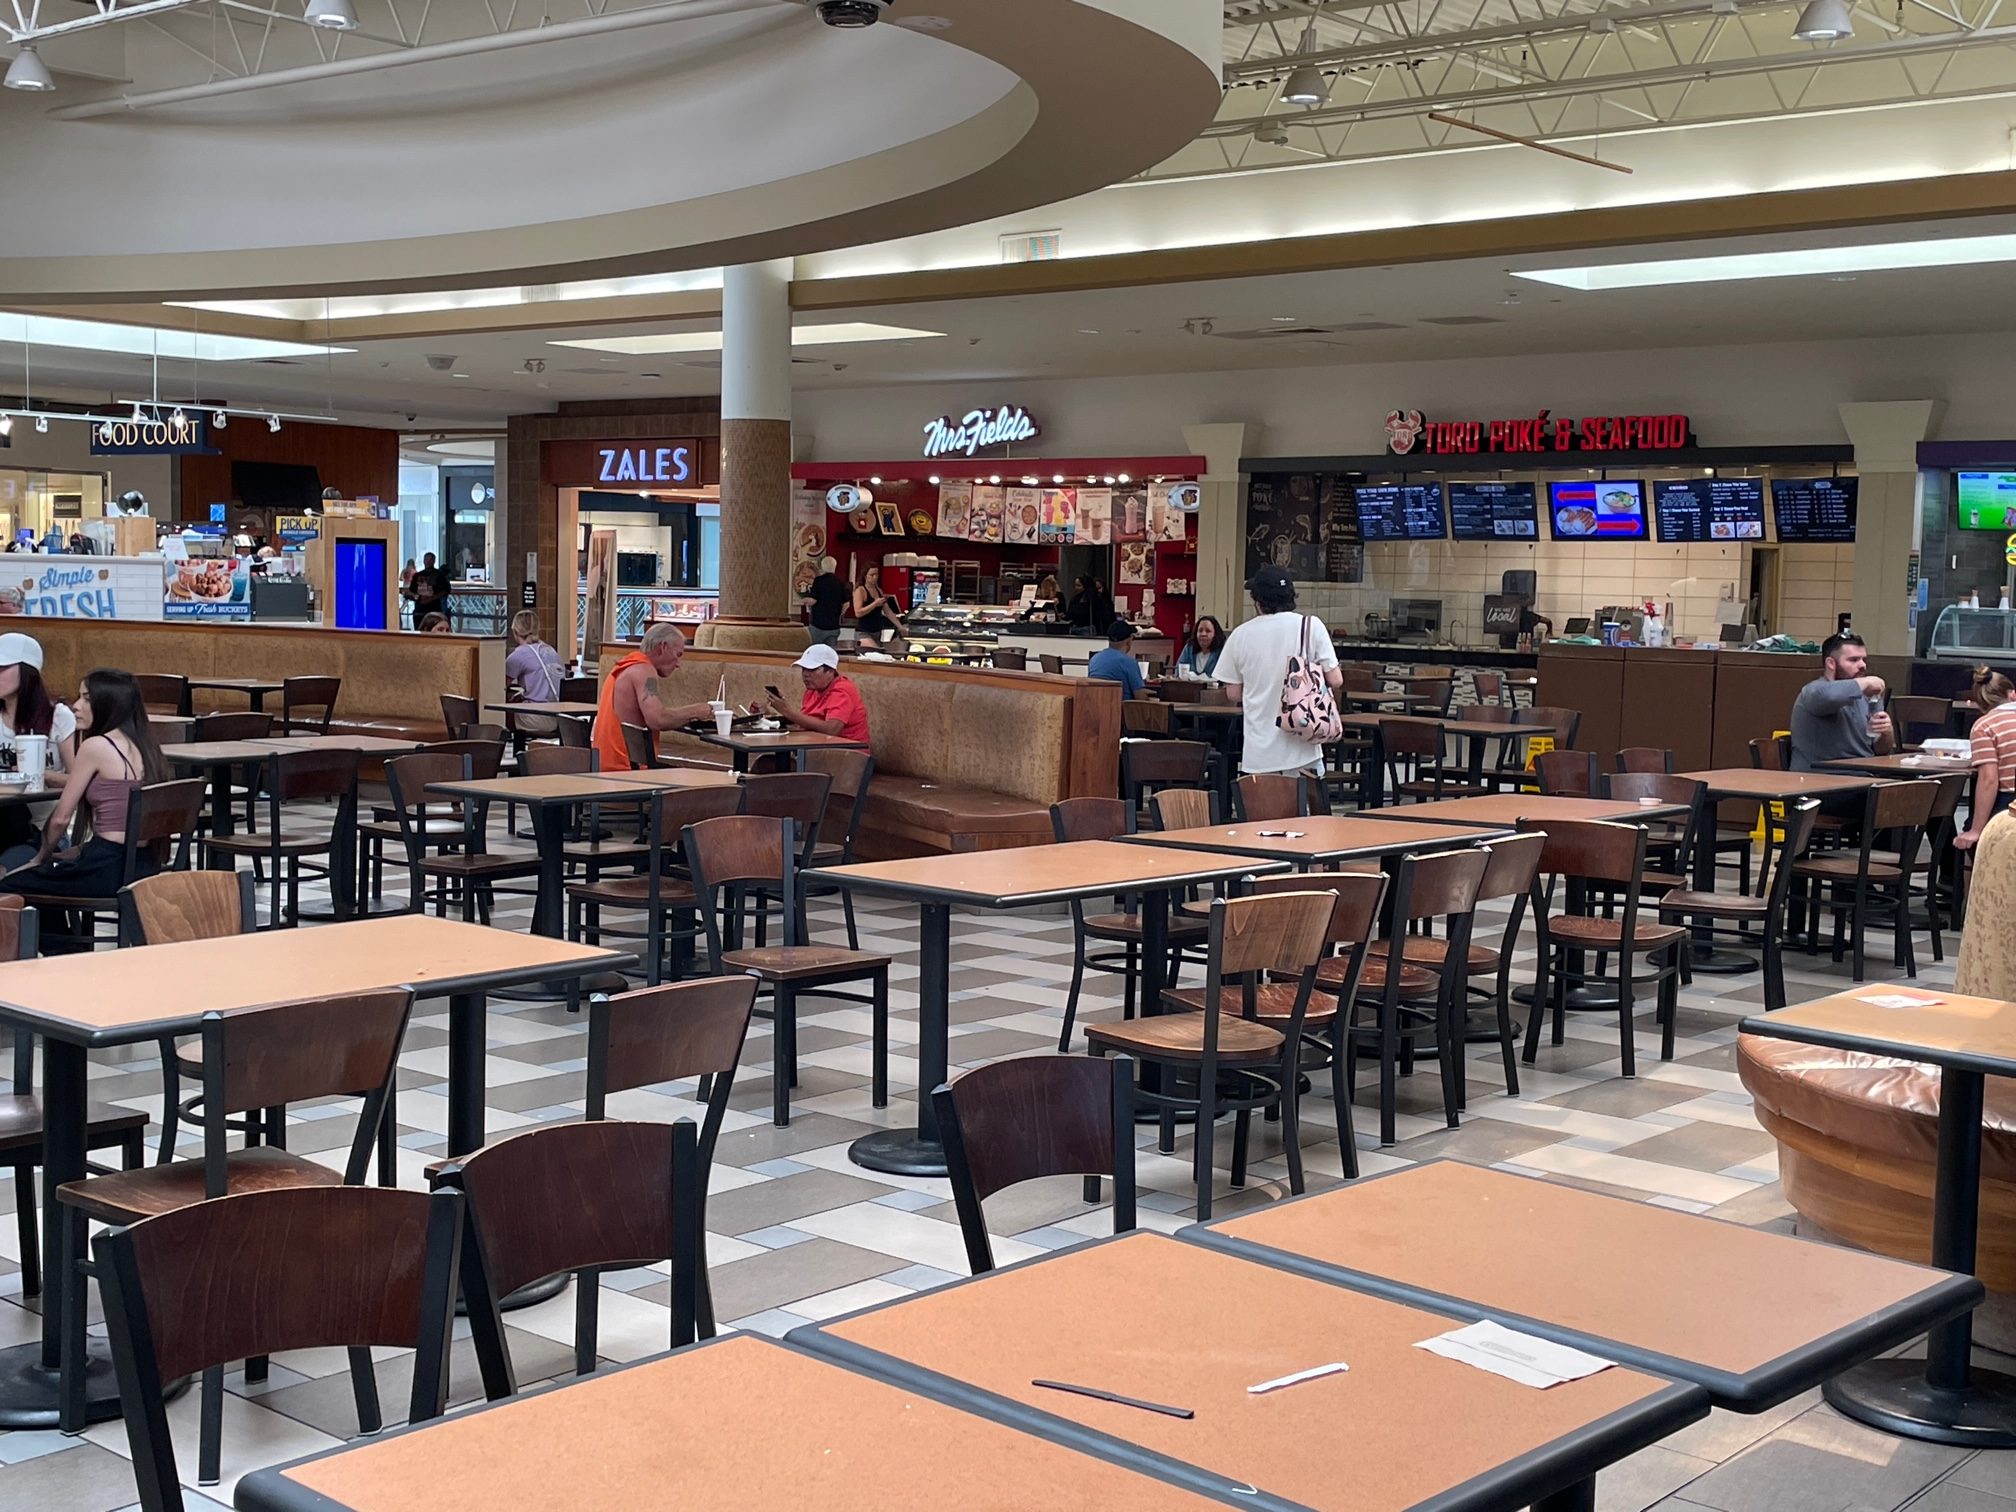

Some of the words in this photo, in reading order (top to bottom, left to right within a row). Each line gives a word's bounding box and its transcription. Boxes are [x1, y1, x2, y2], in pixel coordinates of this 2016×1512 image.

[92, 422, 139, 446] FOOD
[142, 420, 200, 445] COURT
[962, 406, 1036, 456] Fields
[1425, 421, 1480, 454] TORO
[1489, 409, 1548, 454] POKÉ
[1554, 418, 1571, 452] &
[1580, 414, 1687, 450] SEAFOOD
[599, 447, 689, 481] ZALES
[280, 517, 302, 530] PICK
[304, 518, 318, 530] UP
[39, 566, 94, 593] Simple
